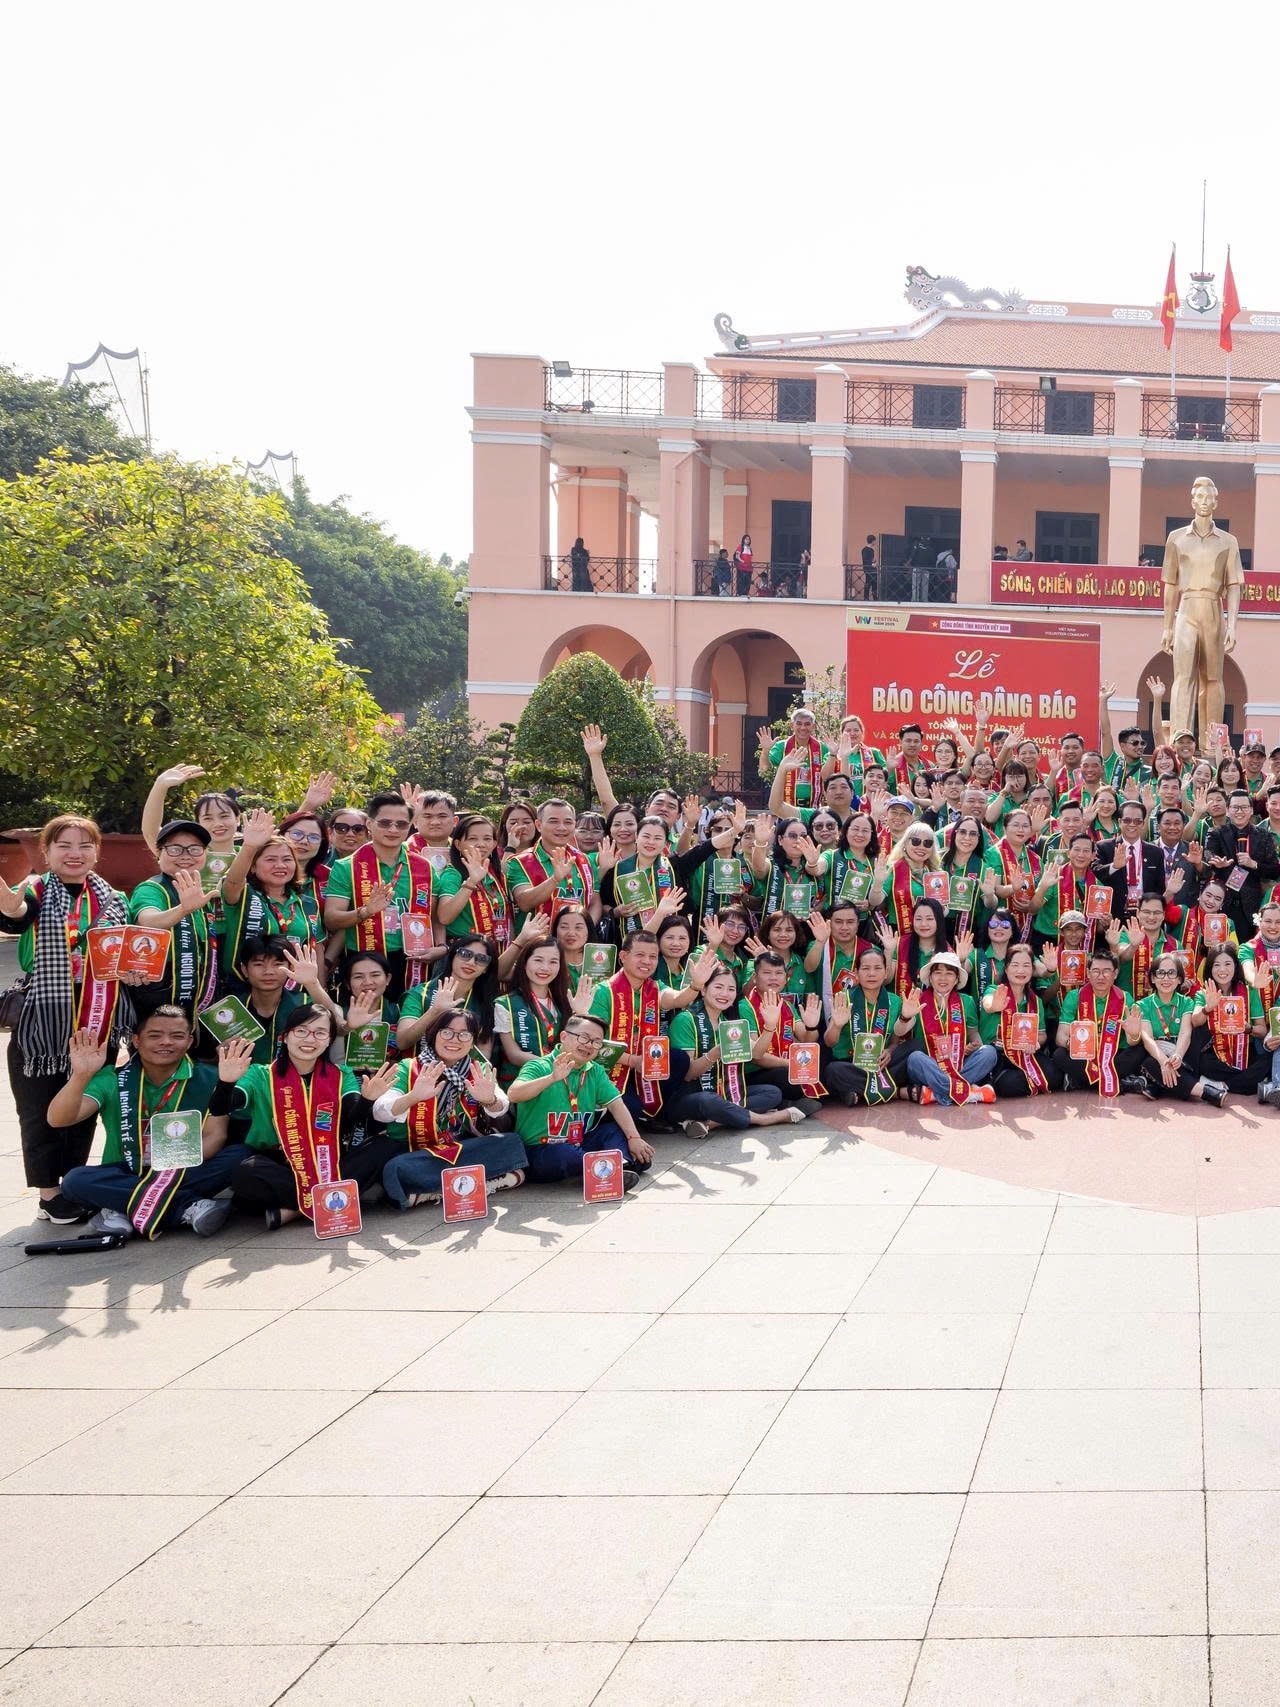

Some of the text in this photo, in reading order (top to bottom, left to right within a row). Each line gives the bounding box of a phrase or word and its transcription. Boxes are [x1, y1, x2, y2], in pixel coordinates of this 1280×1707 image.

[1000, 569, 1035, 596] SỐNG,
[1038, 572, 1072, 594] CHIẾN
[1076, 573, 1101, 598] ĐẤU,
[1104, 579, 1126, 596] LAO
[1129, 576, 1161, 600] ĐỘNG
[1241, 584, 1262, 601] HEO
[855, 616, 871, 624] VNV
[949, 649, 1000, 680] Lễ
[872, 682, 914, 713] BÁO
[920, 683, 974, 716] CÔNG
[1039, 689, 1076, 720] BÁC
[873, 730, 886, 739] VÀ
[416, 883, 429, 908] VNV
[181, 952, 197, 978] NGƯỜI
[181, 978, 196, 991] TỬ
[644, 1000, 655, 1024] VNV
[873, 1009, 888, 1030] VNV
[950, 1003, 962, 1023] VNV
[518, 1008, 530, 1049] Danh hiệu
[1106, 1015, 1119, 1035] VNV
[284, 1109, 300, 1129] CỐNG
[315, 1102, 334, 1131] VNV
[415, 1101, 427, 1122] CỐNG
[287, 1130, 303, 1146] HIẾN
[290, 1145, 304, 1153] VÌ
[291, 1153, 304, 1173] CỘNG
